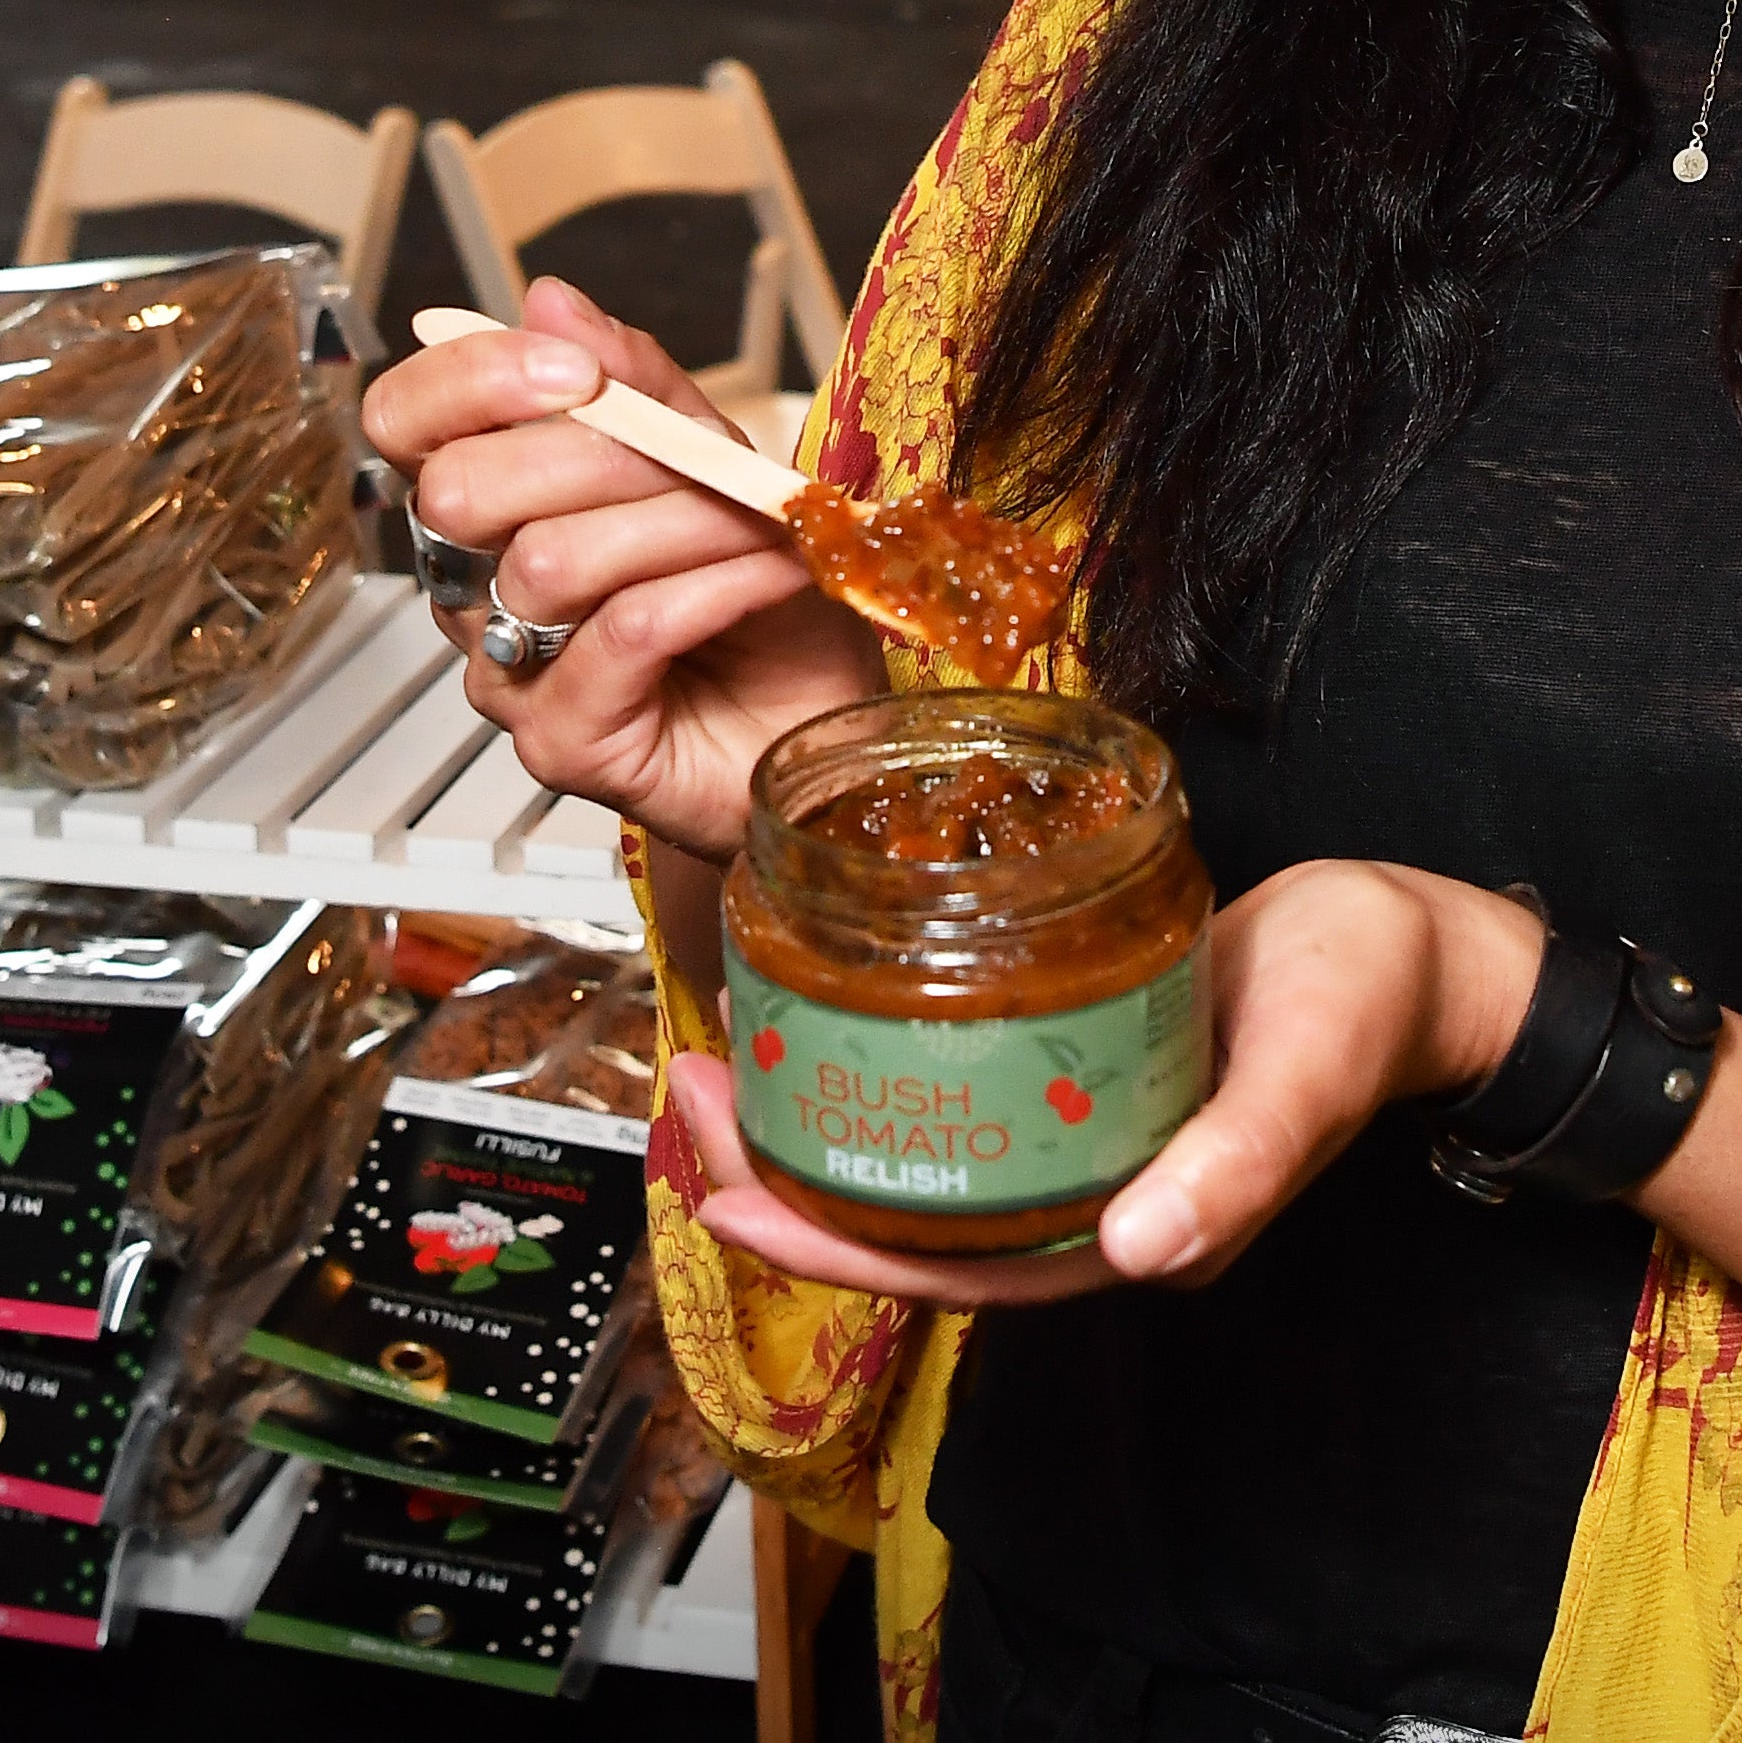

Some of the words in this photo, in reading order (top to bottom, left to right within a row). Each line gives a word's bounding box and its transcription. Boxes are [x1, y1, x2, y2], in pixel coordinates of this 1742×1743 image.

[816, 1060, 972, 1118] BUSH
[792, 1091, 1012, 1164] TOMATO
[474, 1132, 562, 1165] FUSILLI
[825, 1145, 969, 1198] RELISH
[9, 1193, 44, 1218] MY
[369, 1296, 412, 1319] BAG
[414, 1308, 475, 1334] DILLY
[476, 1320, 512, 1340] MY
[26, 1375, 61, 1400] MY
[365, 1553, 408, 1576] BAG
[410, 1561, 472, 1588] DILLY
[474, 1572, 509, 1594] MY
